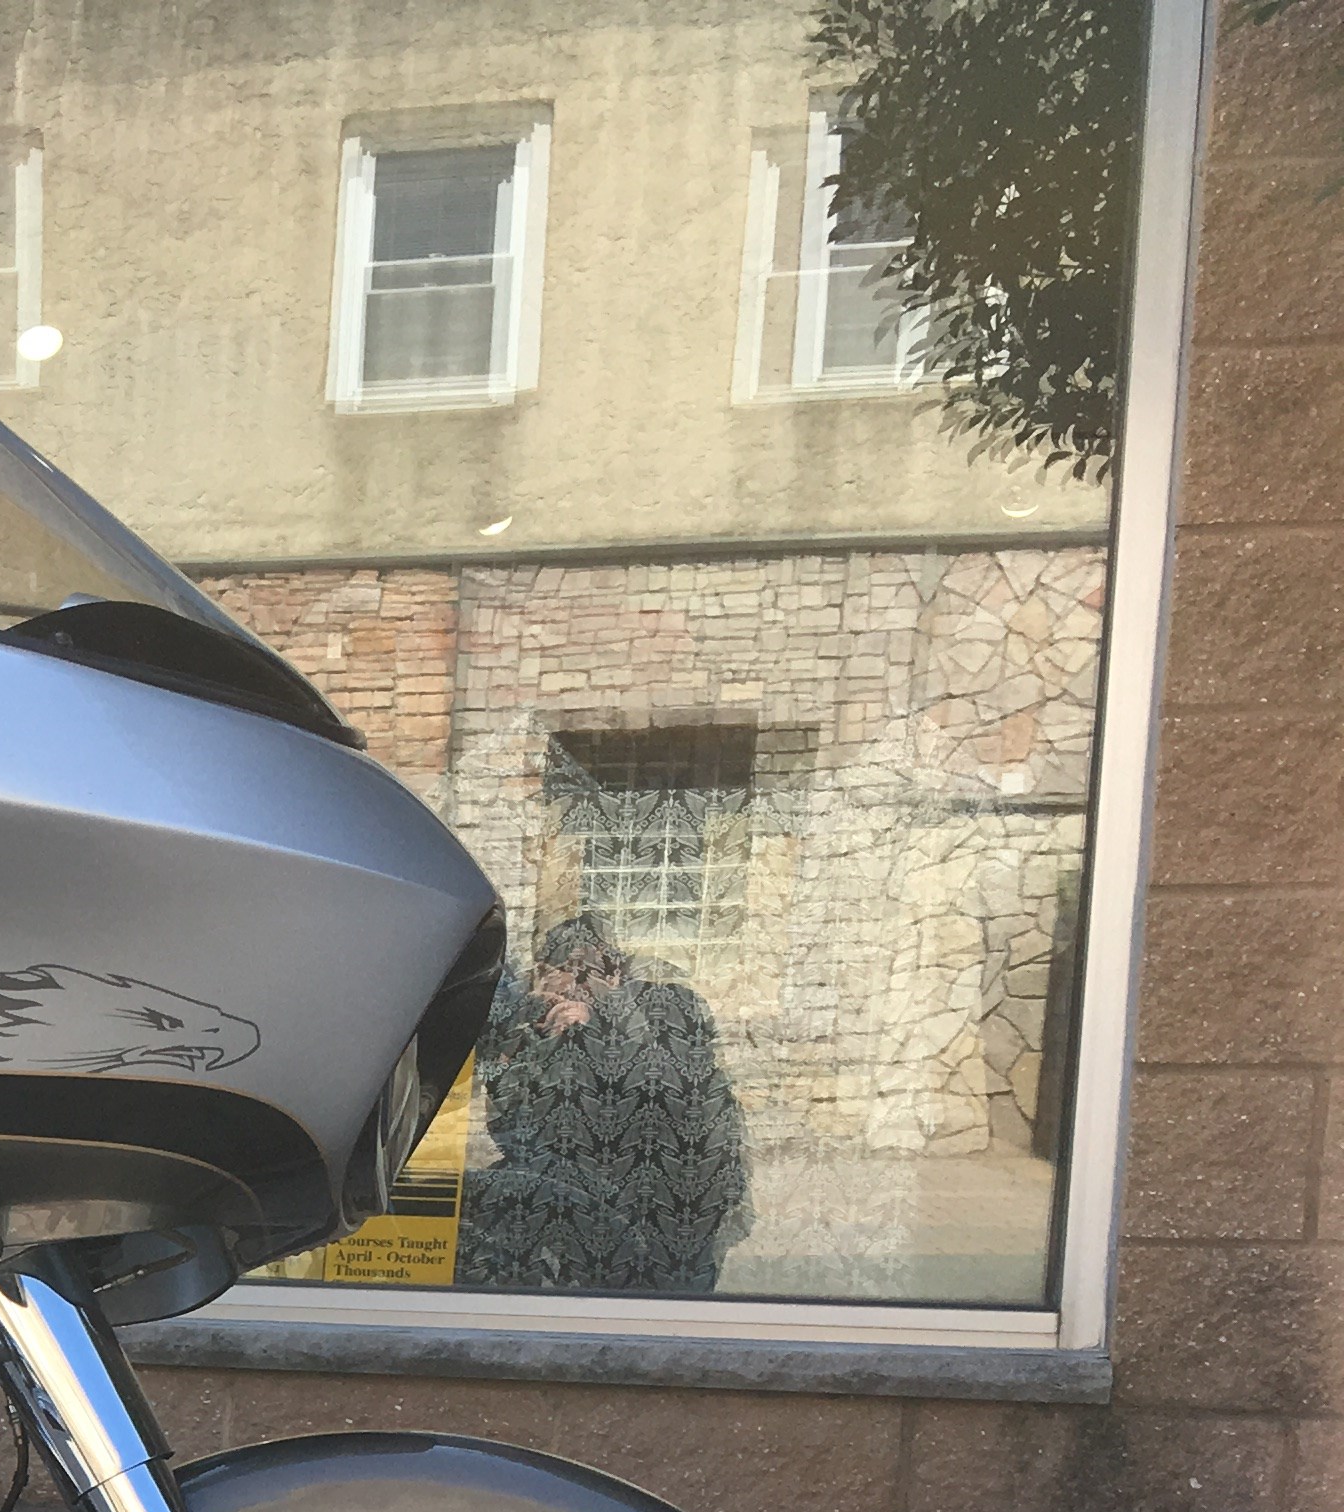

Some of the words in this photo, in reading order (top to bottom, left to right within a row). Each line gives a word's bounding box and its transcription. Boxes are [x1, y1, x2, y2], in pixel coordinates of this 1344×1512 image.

[397, 1236, 449, 1252] Taught
[336, 1249, 372, 1263] April
[386, 1251, 446, 1265] October
[334, 1264, 411, 1278] Thousands
